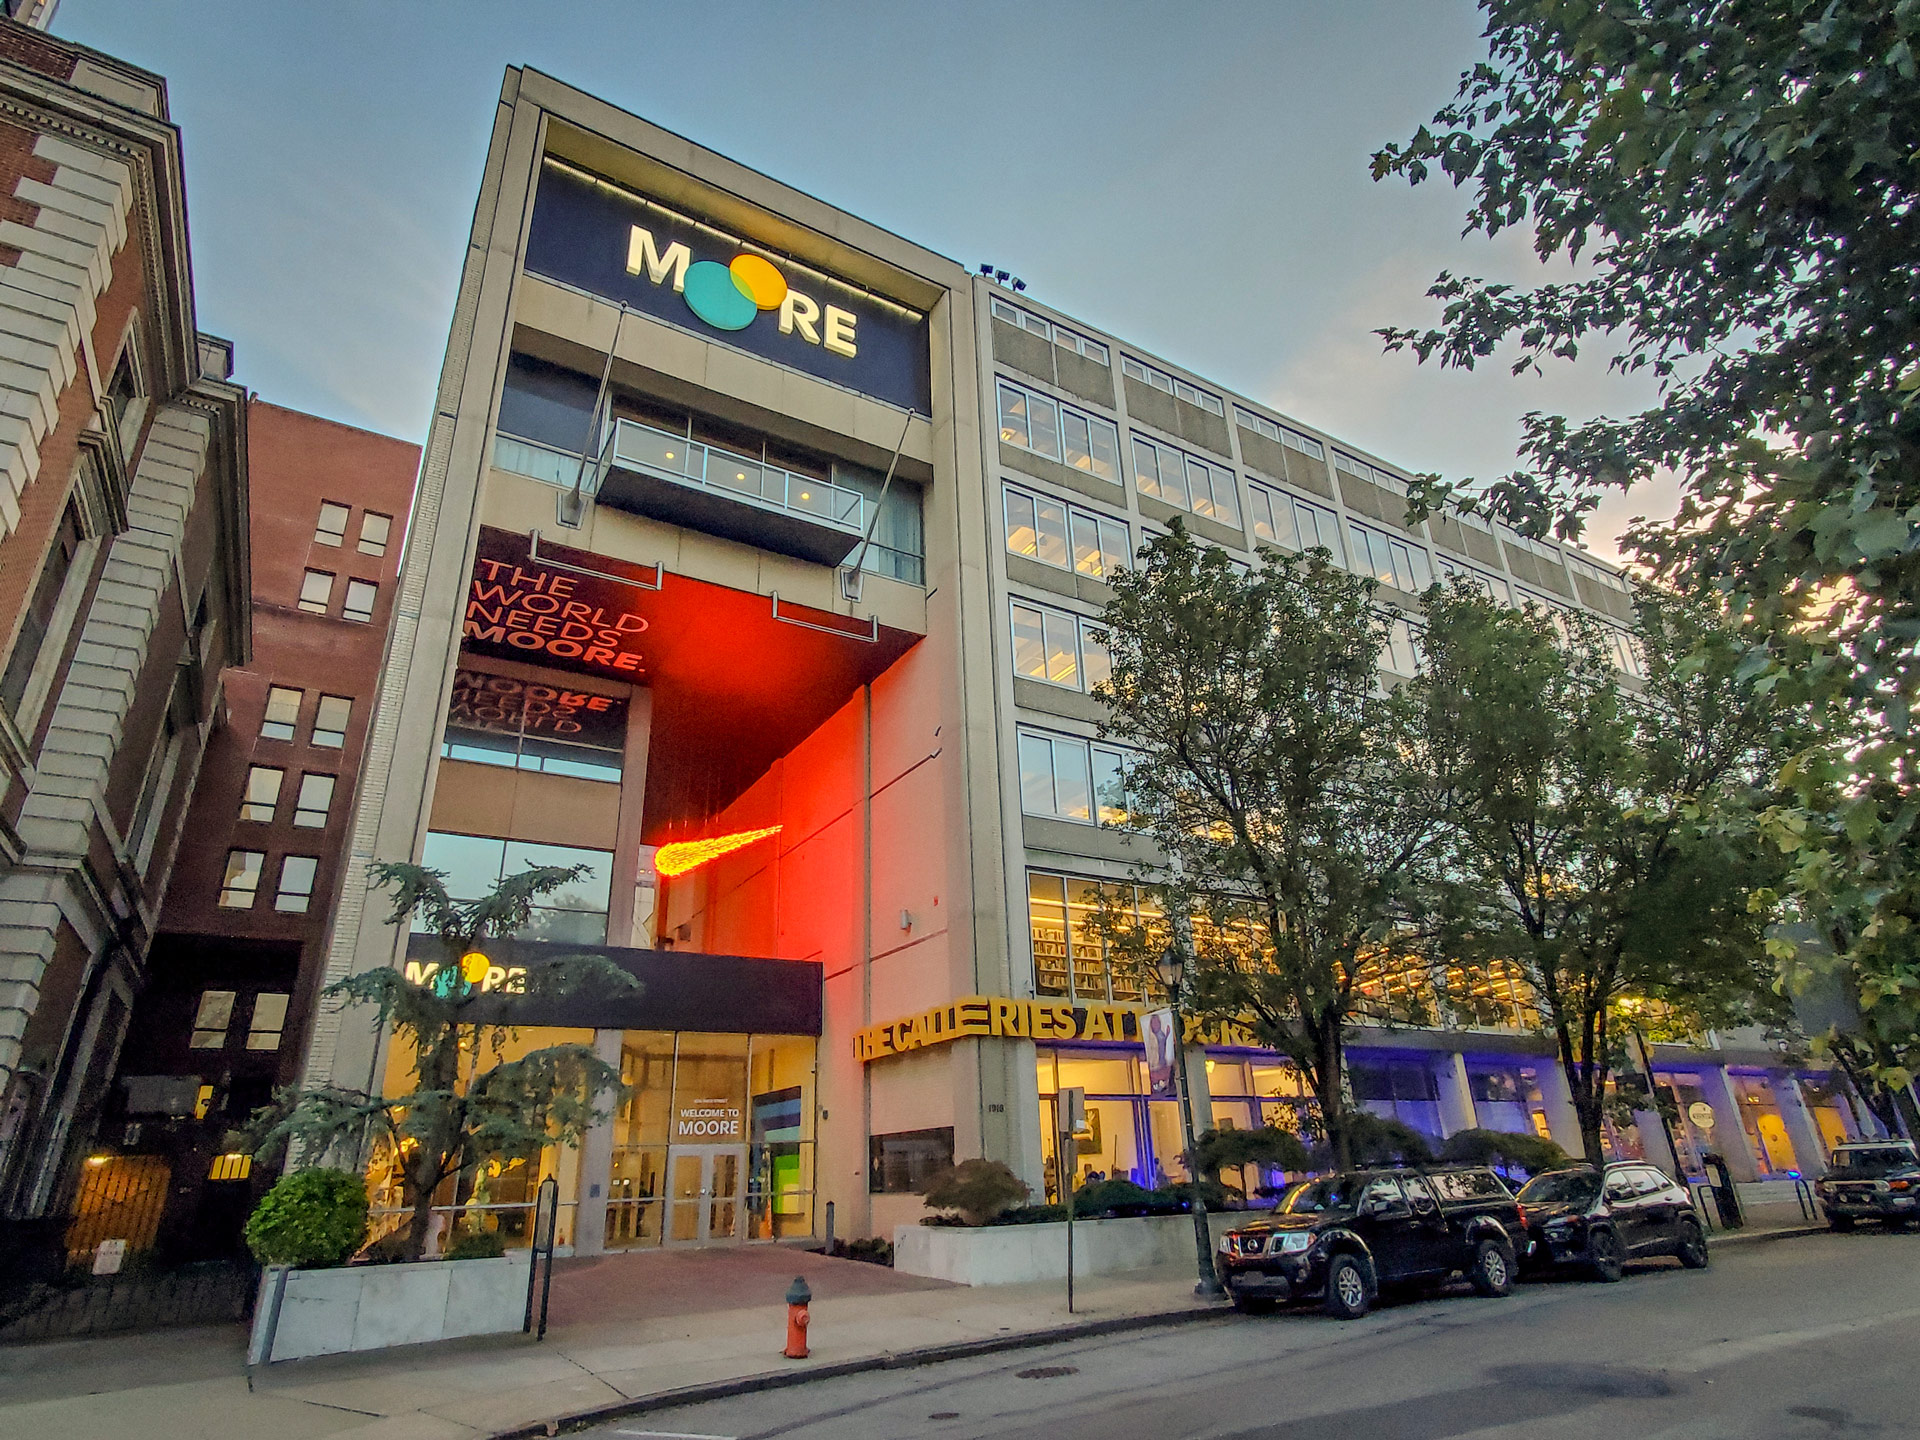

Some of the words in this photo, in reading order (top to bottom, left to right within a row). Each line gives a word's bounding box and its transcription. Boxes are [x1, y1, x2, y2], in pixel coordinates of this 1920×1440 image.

[626, 224, 857, 358] MOORE
[481, 558, 578, 599] THE
[467, 600, 622, 647] NEEDS
[474, 580, 649, 633] WORLD
[464, 620, 646, 673] MOORE.
[852, 1019, 892, 1062] THE
[892, 997, 1078, 1052] GALLERIES
[1082, 1004, 1129, 1042] AT
[678, 1120, 739, 1136] MOORE
[680, 1108, 725, 1117] WELCOME
[727, 1108, 740, 1117] TO
